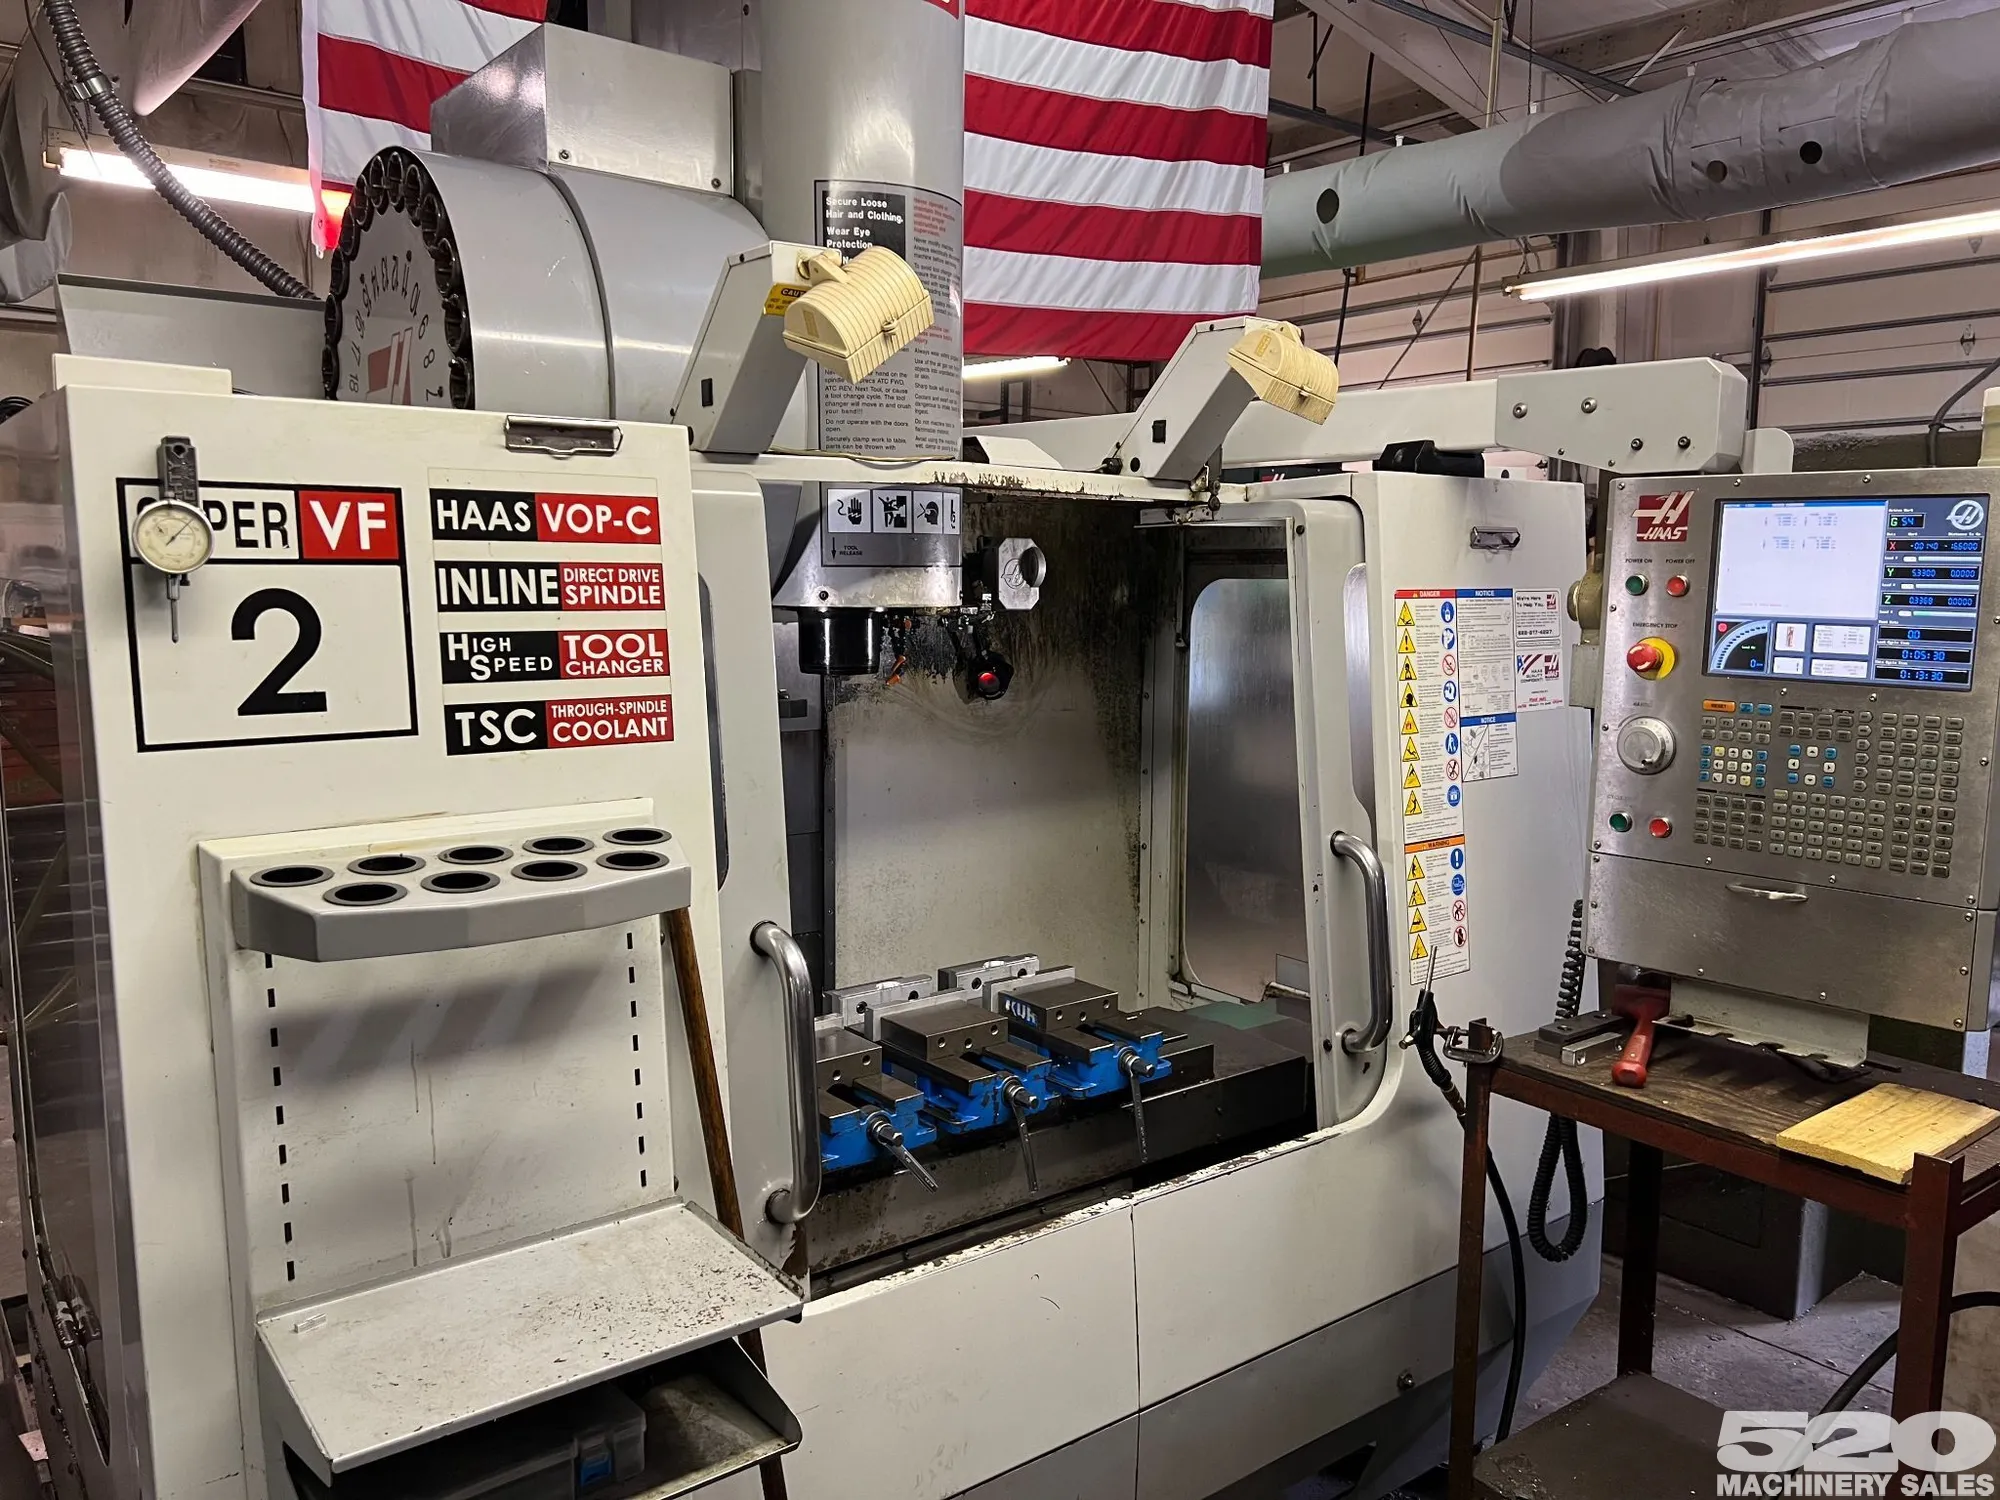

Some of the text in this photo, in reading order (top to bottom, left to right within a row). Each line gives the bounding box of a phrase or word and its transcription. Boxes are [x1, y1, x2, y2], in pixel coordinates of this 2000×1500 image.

[826, 197, 887, 208] Secure Loose
[826, 210, 844, 219] Hair
[848, 210, 864, 219] and
[826, 226, 870, 237] Wear Eye
[826, 240, 872, 248] Protection
[352, 341, 361, 367] 17
[424, 349, 435, 369] 8
[349, 374, 359, 394] 18
[138, 497, 386, 550] PER VF
[436, 500, 652, 535] HAAS VOP-C
[1890, 517, 1897, 526] G
[1637, 526, 1688, 540] HAAS
[1889, 542, 1896, 550] X
[563, 568, 659, 583] DIRECT DRIVE
[1887, 568, 1894, 576] Y
[438, 568, 559, 605] INLINE
[565, 585, 661, 605] SPINDLE
[1885, 596, 1891, 604] Z
[231, 588, 327, 716] 2
[448, 633, 511, 661] HIGH
[563, 634, 664, 660] TOOL
[470, 654, 553, 681] SPEED
[565, 659, 664, 676] CHANGER
[551, 700, 667, 719] THROUGH-SPINDLE
[455, 709, 537, 746] TSC
[552, 717, 668, 742] COOLANT
[1428, 840, 1449, 848] WARNING
